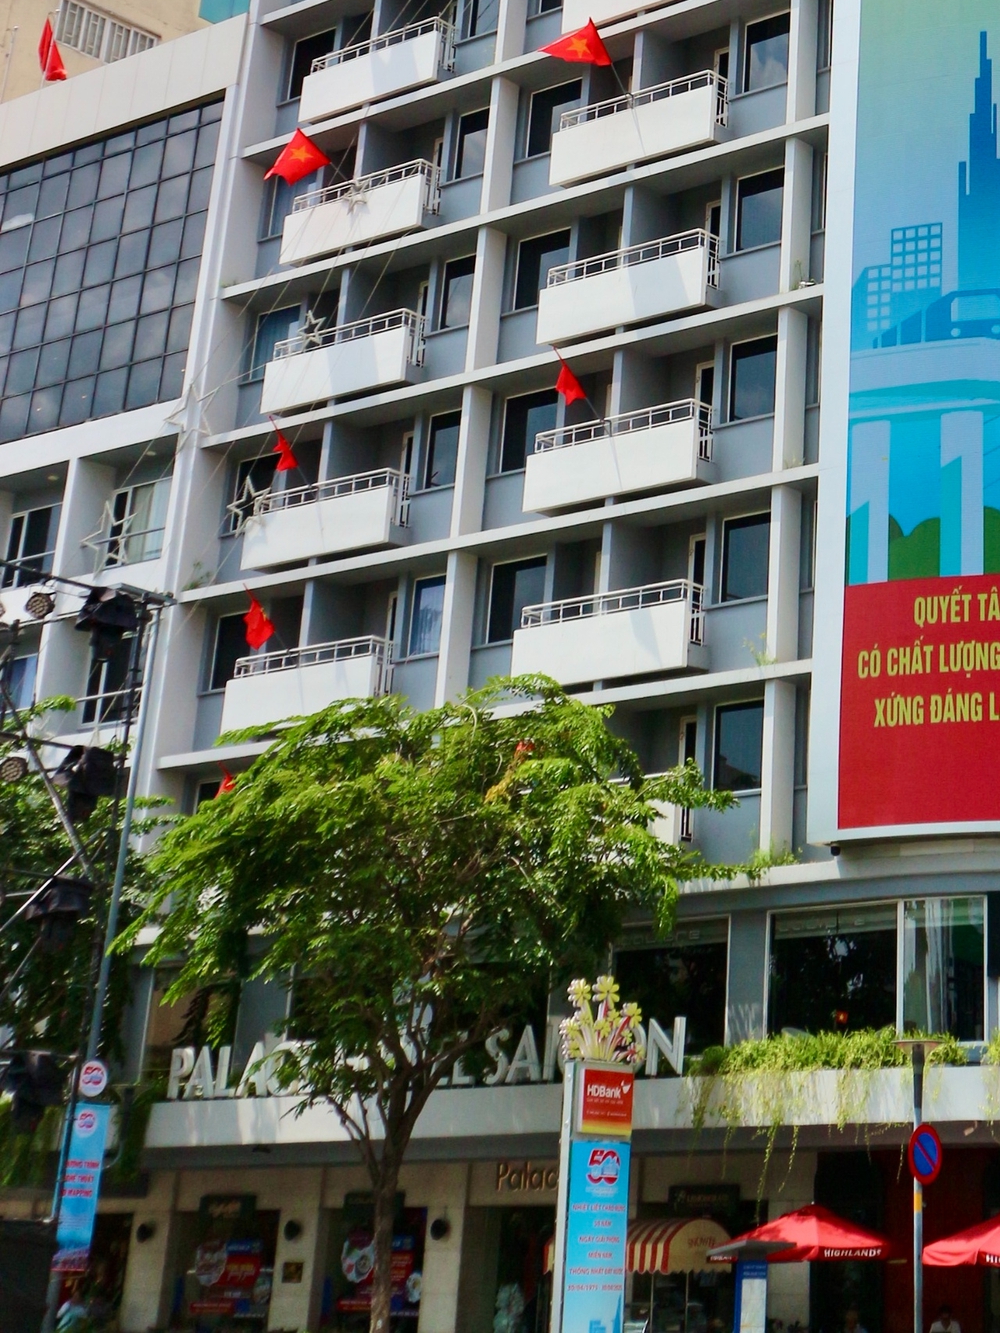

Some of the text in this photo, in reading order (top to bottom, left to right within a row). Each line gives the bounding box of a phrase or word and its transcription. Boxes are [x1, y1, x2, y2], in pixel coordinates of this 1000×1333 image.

[914, 585, 972, 628] QUYẾT
[858, 643, 881, 679] CÓ
[887, 635, 933, 677] CHẤT
[874, 691, 924, 728] XỨNG
[930, 687, 983, 724] ĐÁNG
[483, 1016, 686, 1085] SAIN
[587, 1084, 621, 1098] HDBank
[497, 1160, 559, 1193] Palac
[824, 1248, 882, 1258] HIGHLANDS
